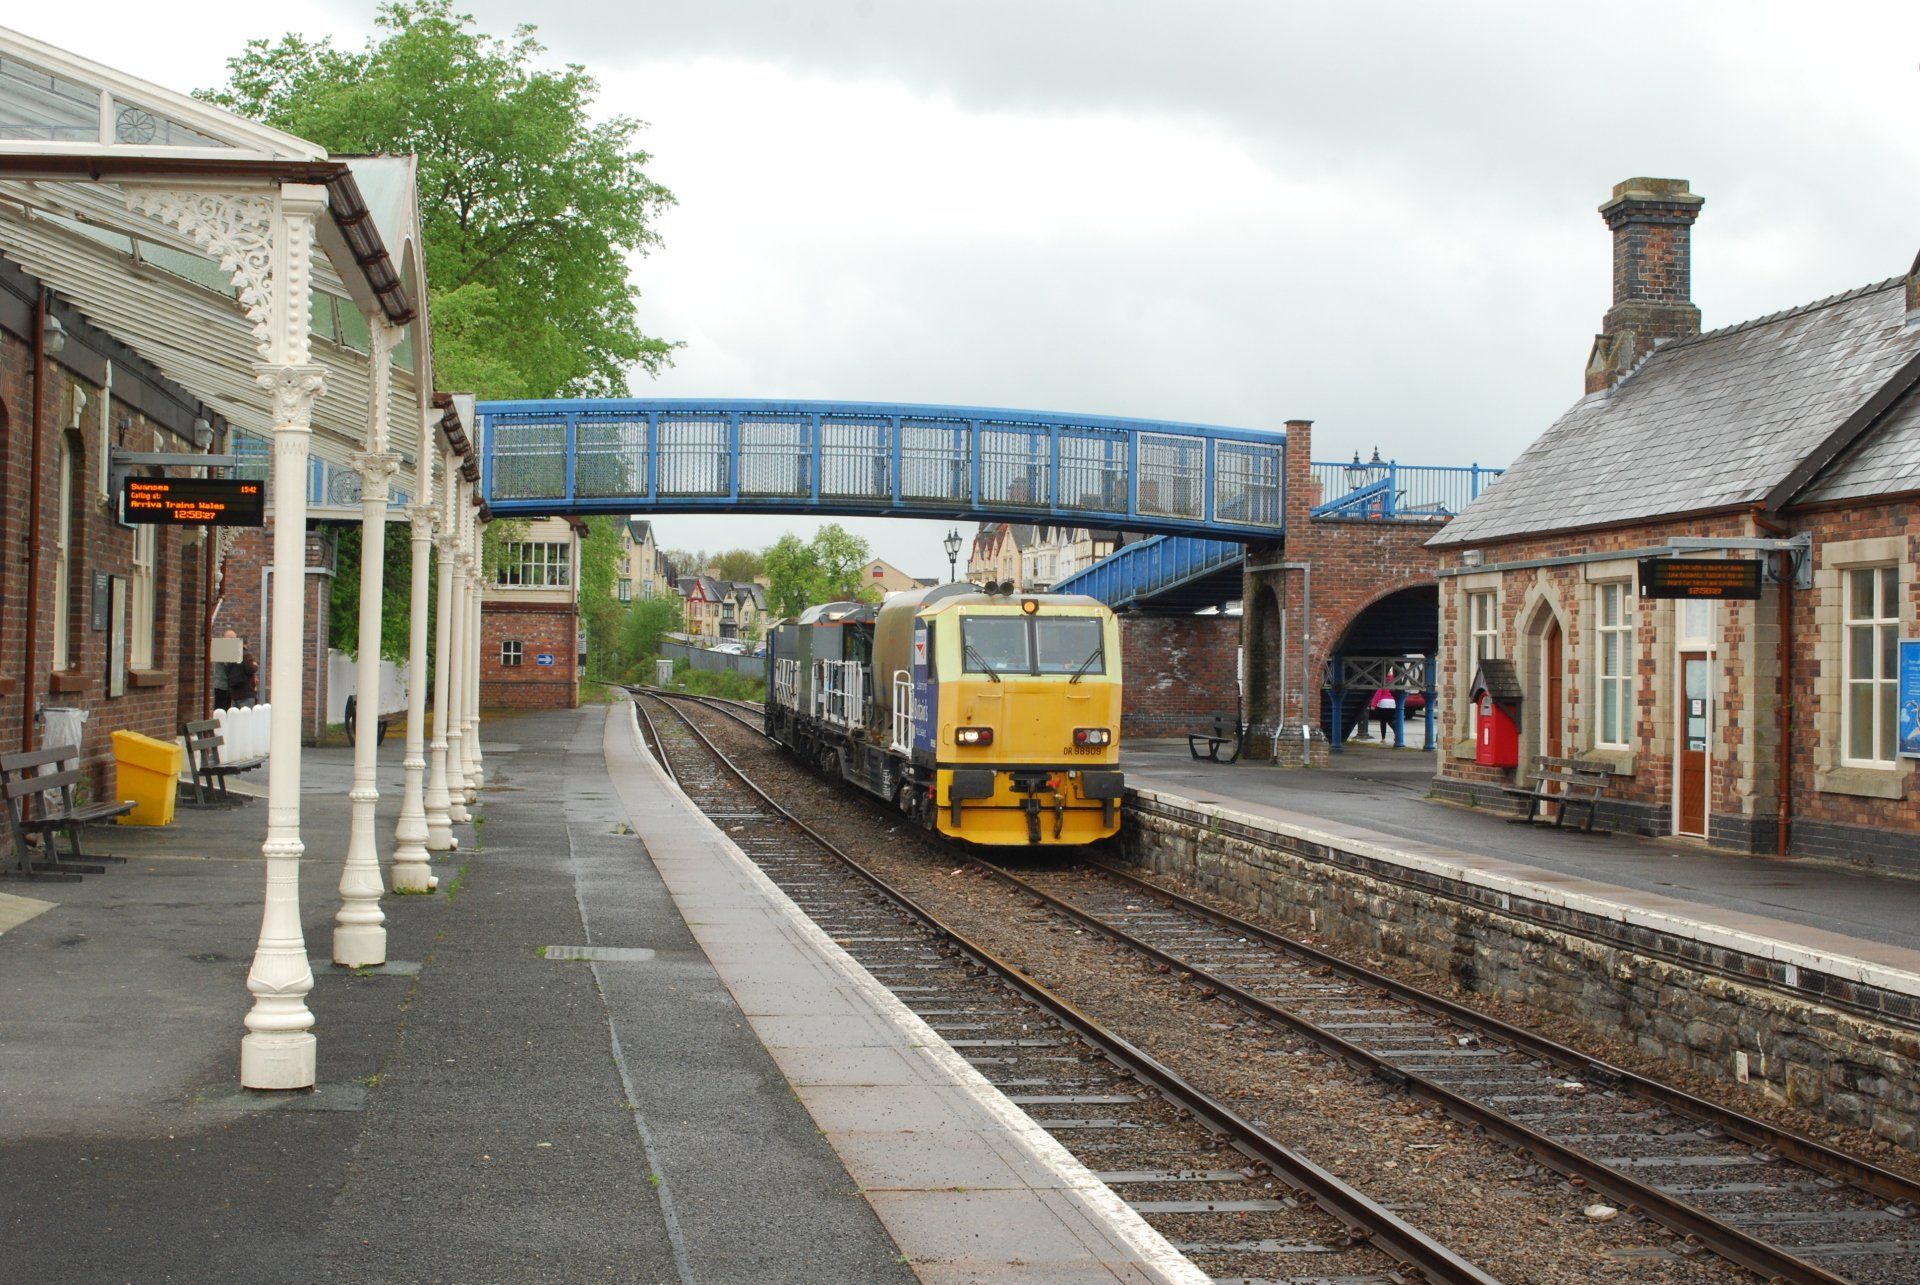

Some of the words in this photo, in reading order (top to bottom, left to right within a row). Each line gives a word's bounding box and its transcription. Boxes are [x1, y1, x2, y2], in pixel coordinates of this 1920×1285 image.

[131, 483, 169, 491] Swansea
[165, 501, 195, 509] Trains
[199, 502, 225, 510] Wales
[1074, 746, 1102, 756] 98909
